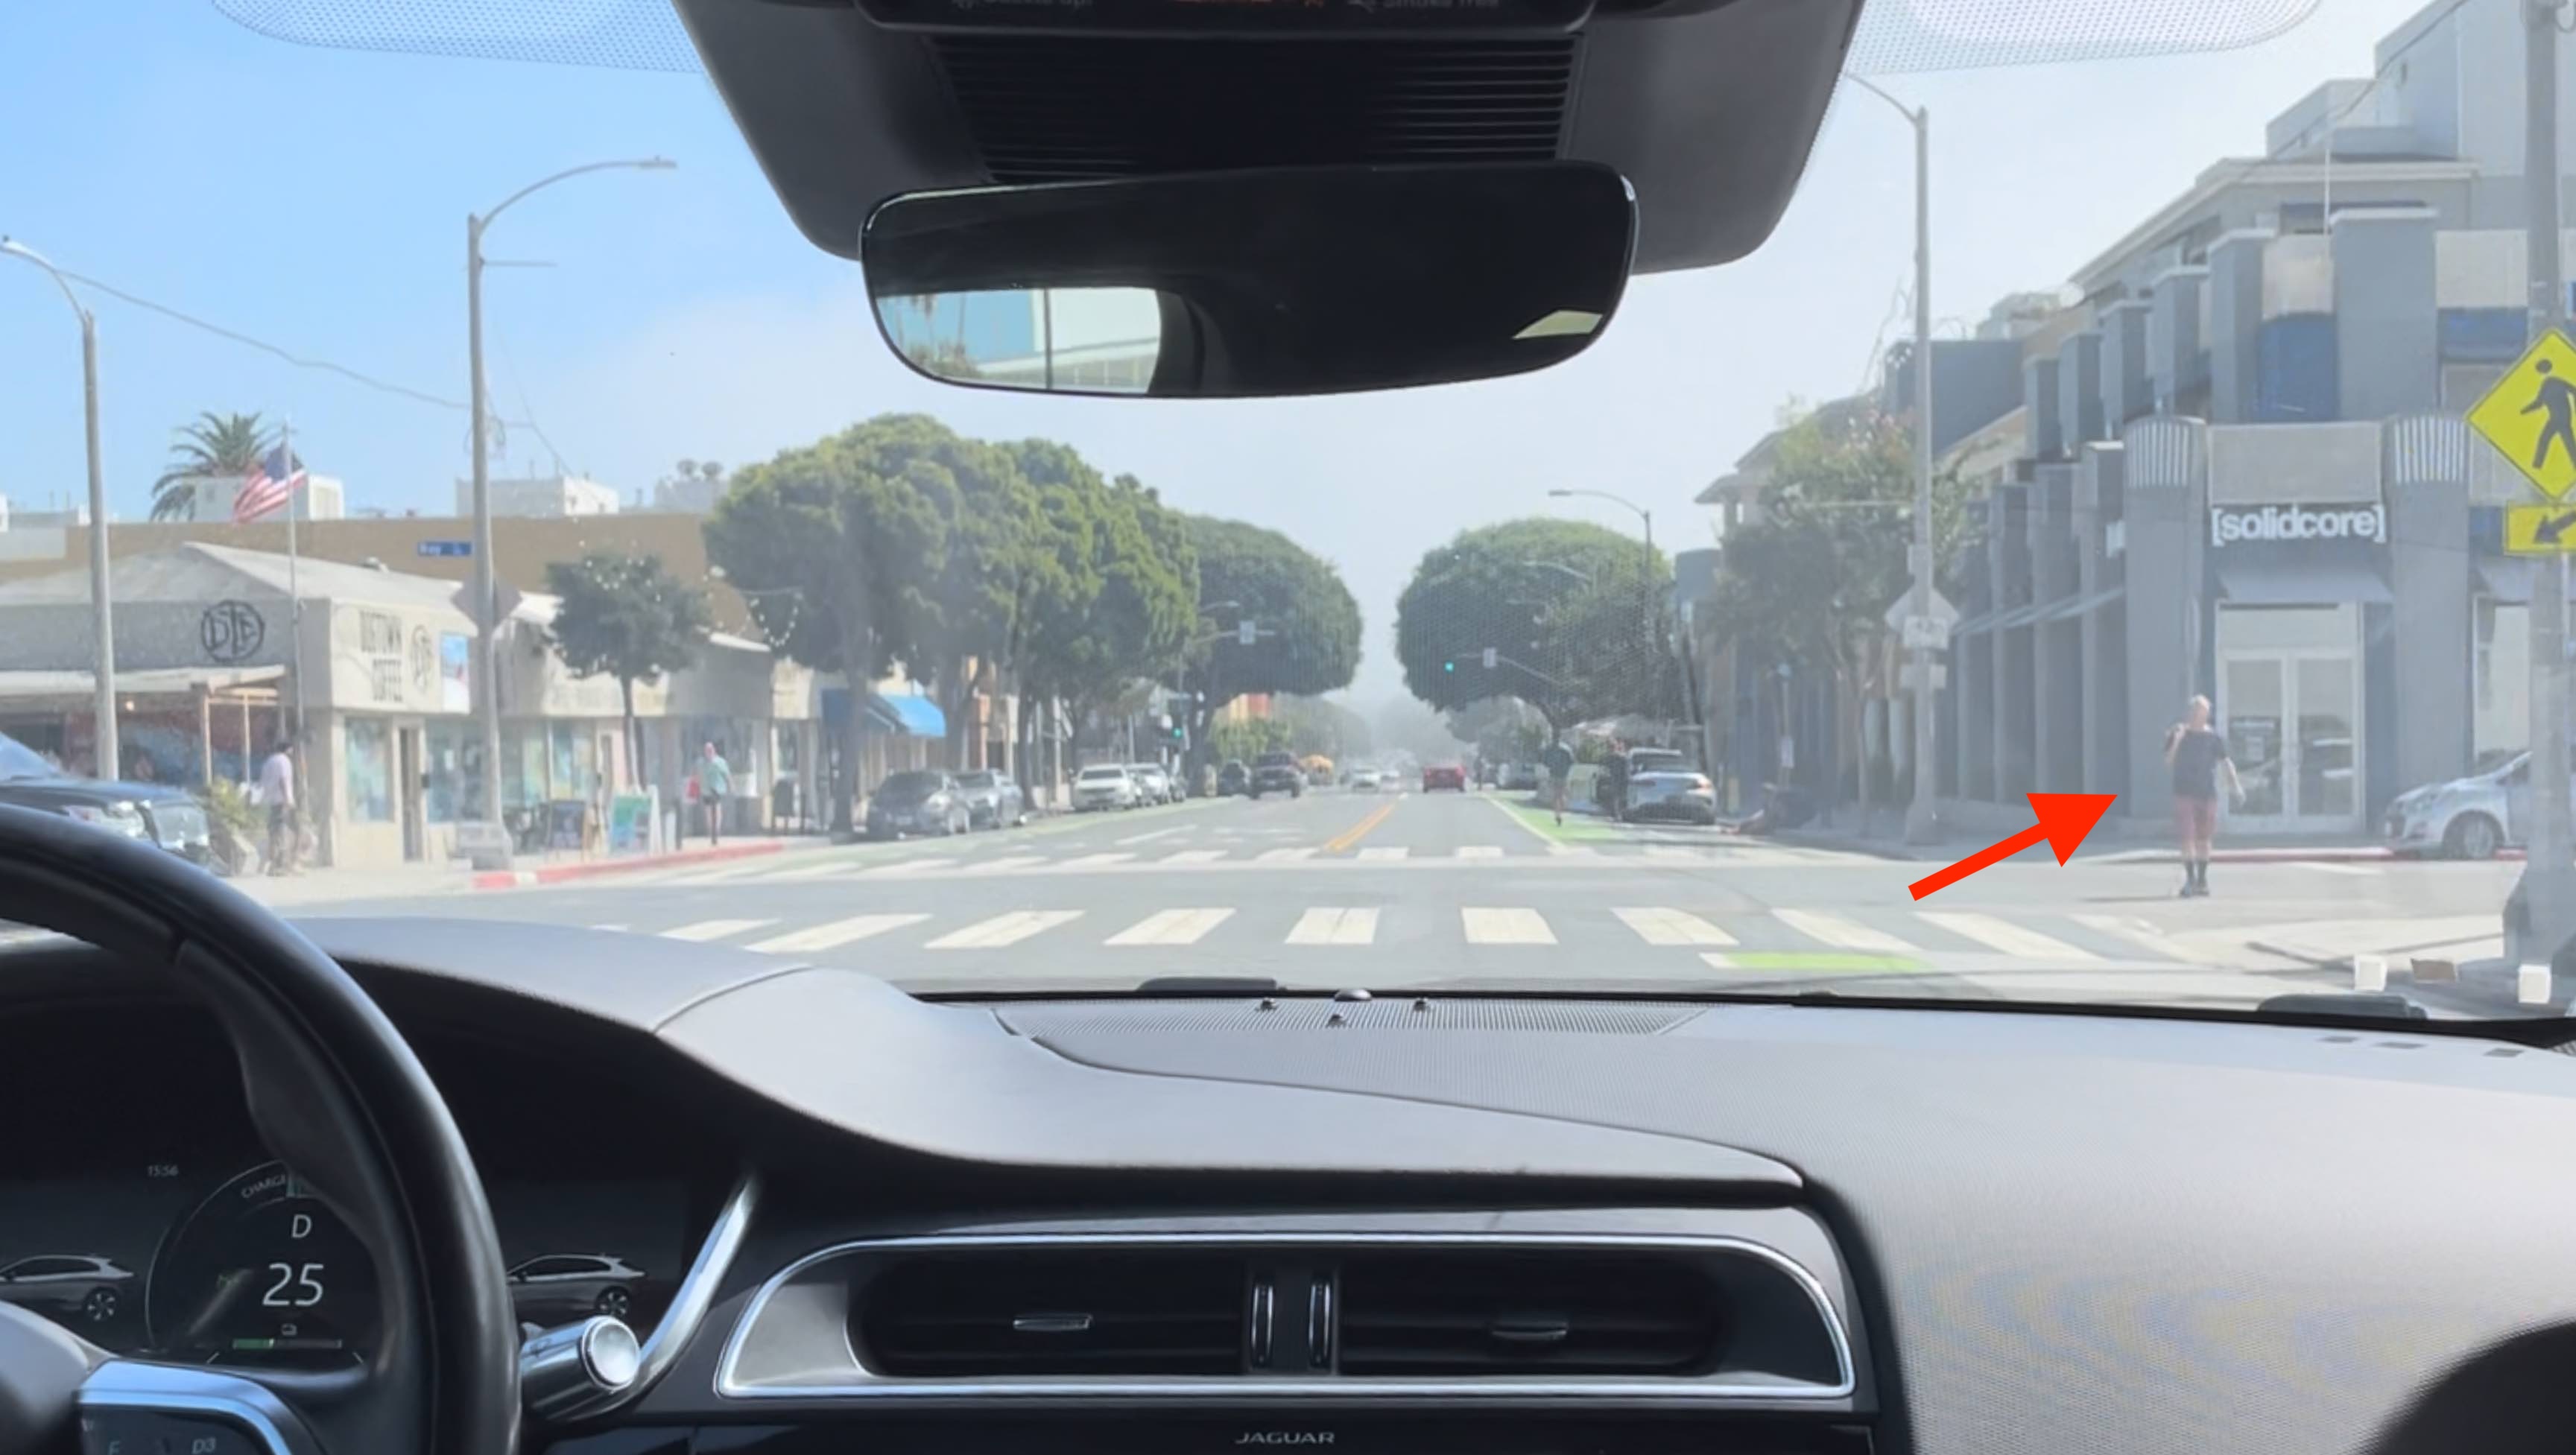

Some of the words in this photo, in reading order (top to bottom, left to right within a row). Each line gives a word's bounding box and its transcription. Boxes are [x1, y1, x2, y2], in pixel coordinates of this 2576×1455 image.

[291, 1214, 311, 1238] D
[263, 1262, 323, 1305] 25
[1235, 1432, 1335, 1444] JAGUAR
